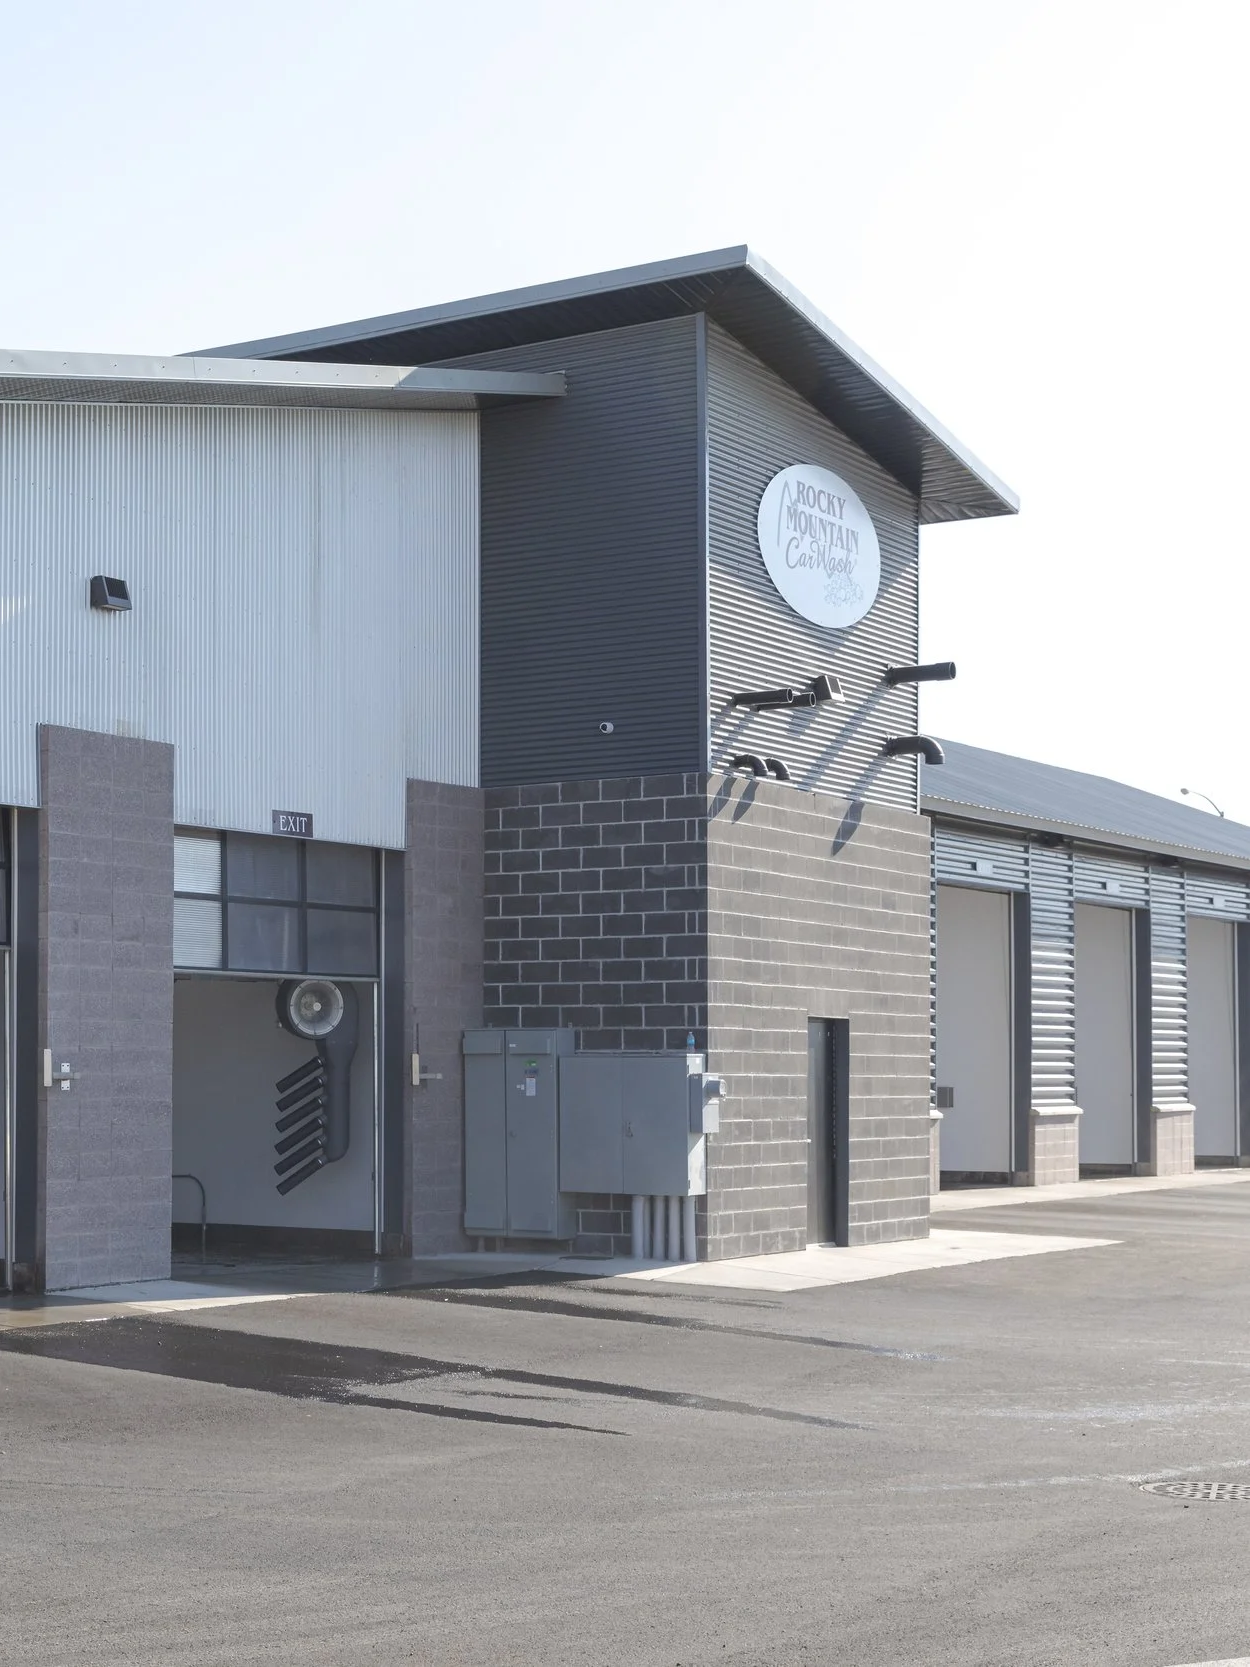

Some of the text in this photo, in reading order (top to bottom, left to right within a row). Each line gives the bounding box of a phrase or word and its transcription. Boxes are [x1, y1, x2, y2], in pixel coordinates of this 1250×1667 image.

[796, 480, 846, 520] ROCKY
[786, 504, 859, 555] MOUNTAIN
[279, 815, 307, 833] EXIT
